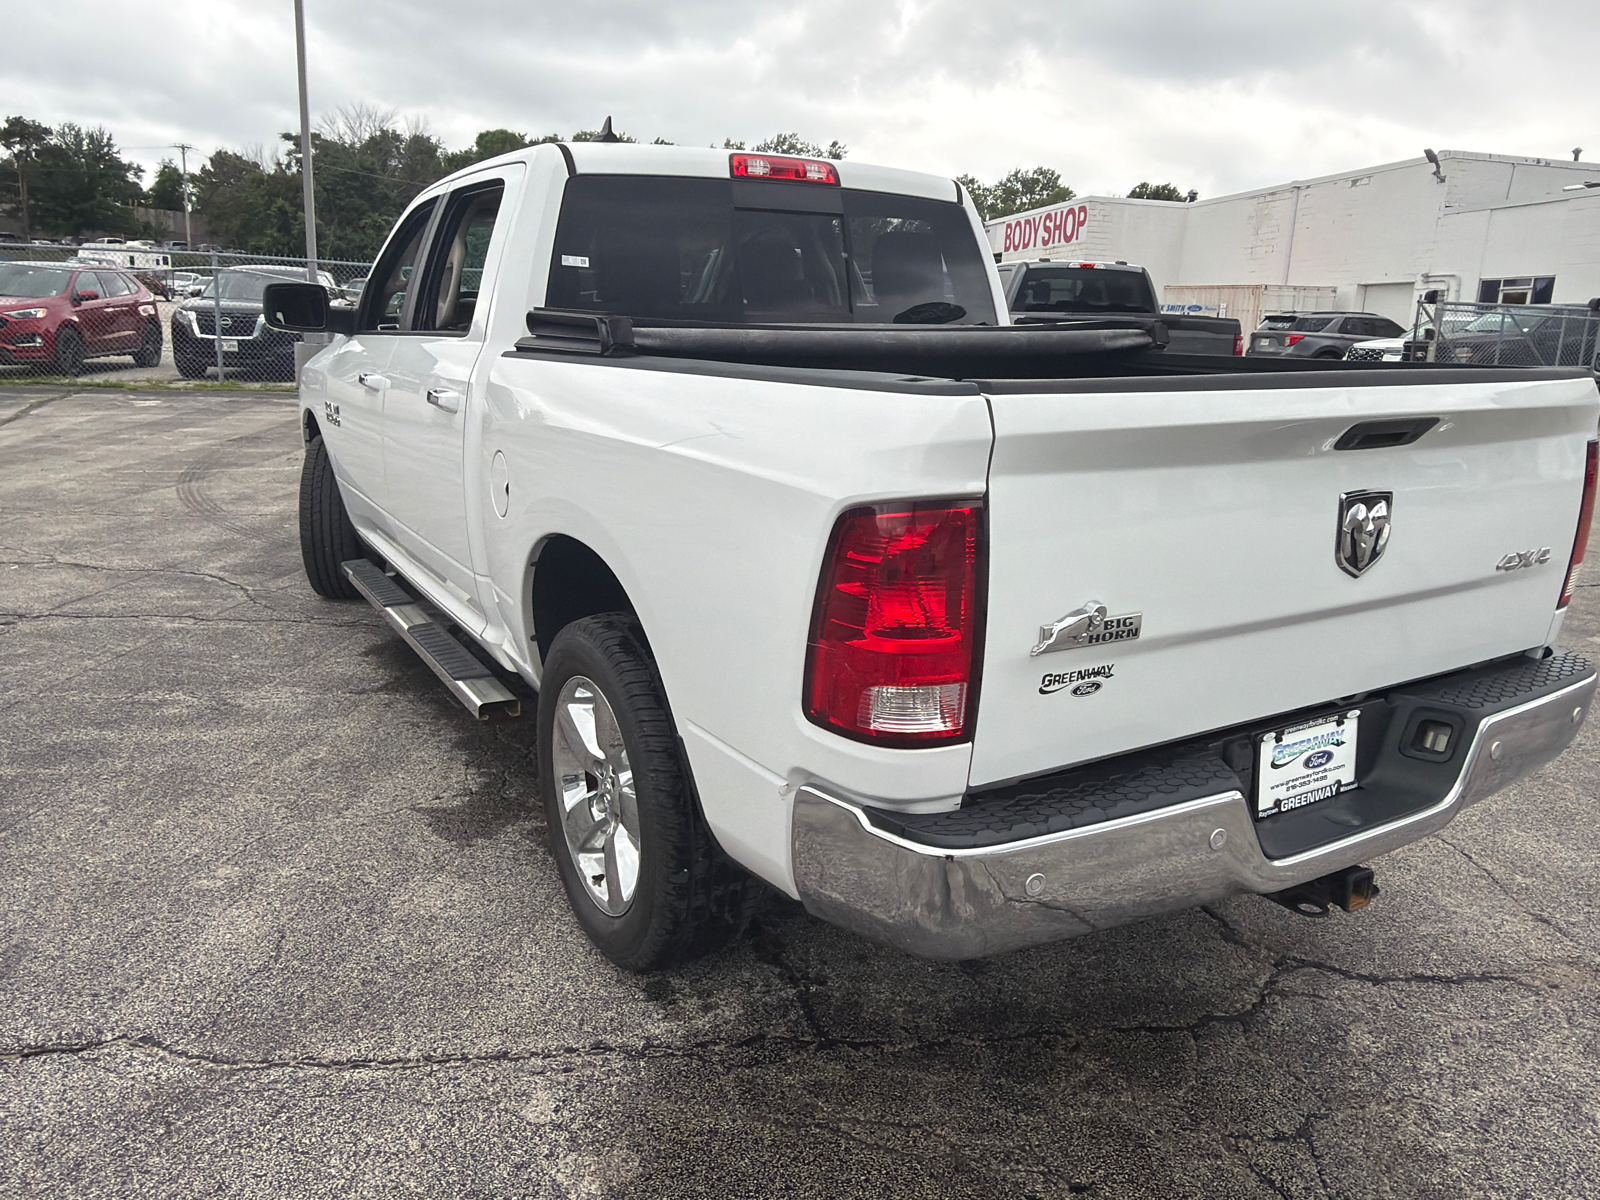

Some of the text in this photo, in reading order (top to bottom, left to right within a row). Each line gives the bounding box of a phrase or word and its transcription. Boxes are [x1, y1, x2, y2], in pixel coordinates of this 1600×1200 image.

[1004, 205, 1088, 253] BODY SHOP
[1087, 627, 1139, 644] HORN
[1103, 616, 1134, 631] BIG
[1040, 663, 1115, 688] GREENWAY
[1271, 729, 1346, 763] GREENWAY
[1308, 753, 1328, 768] Ford
[1280, 783, 1338, 812] GREENWAY
